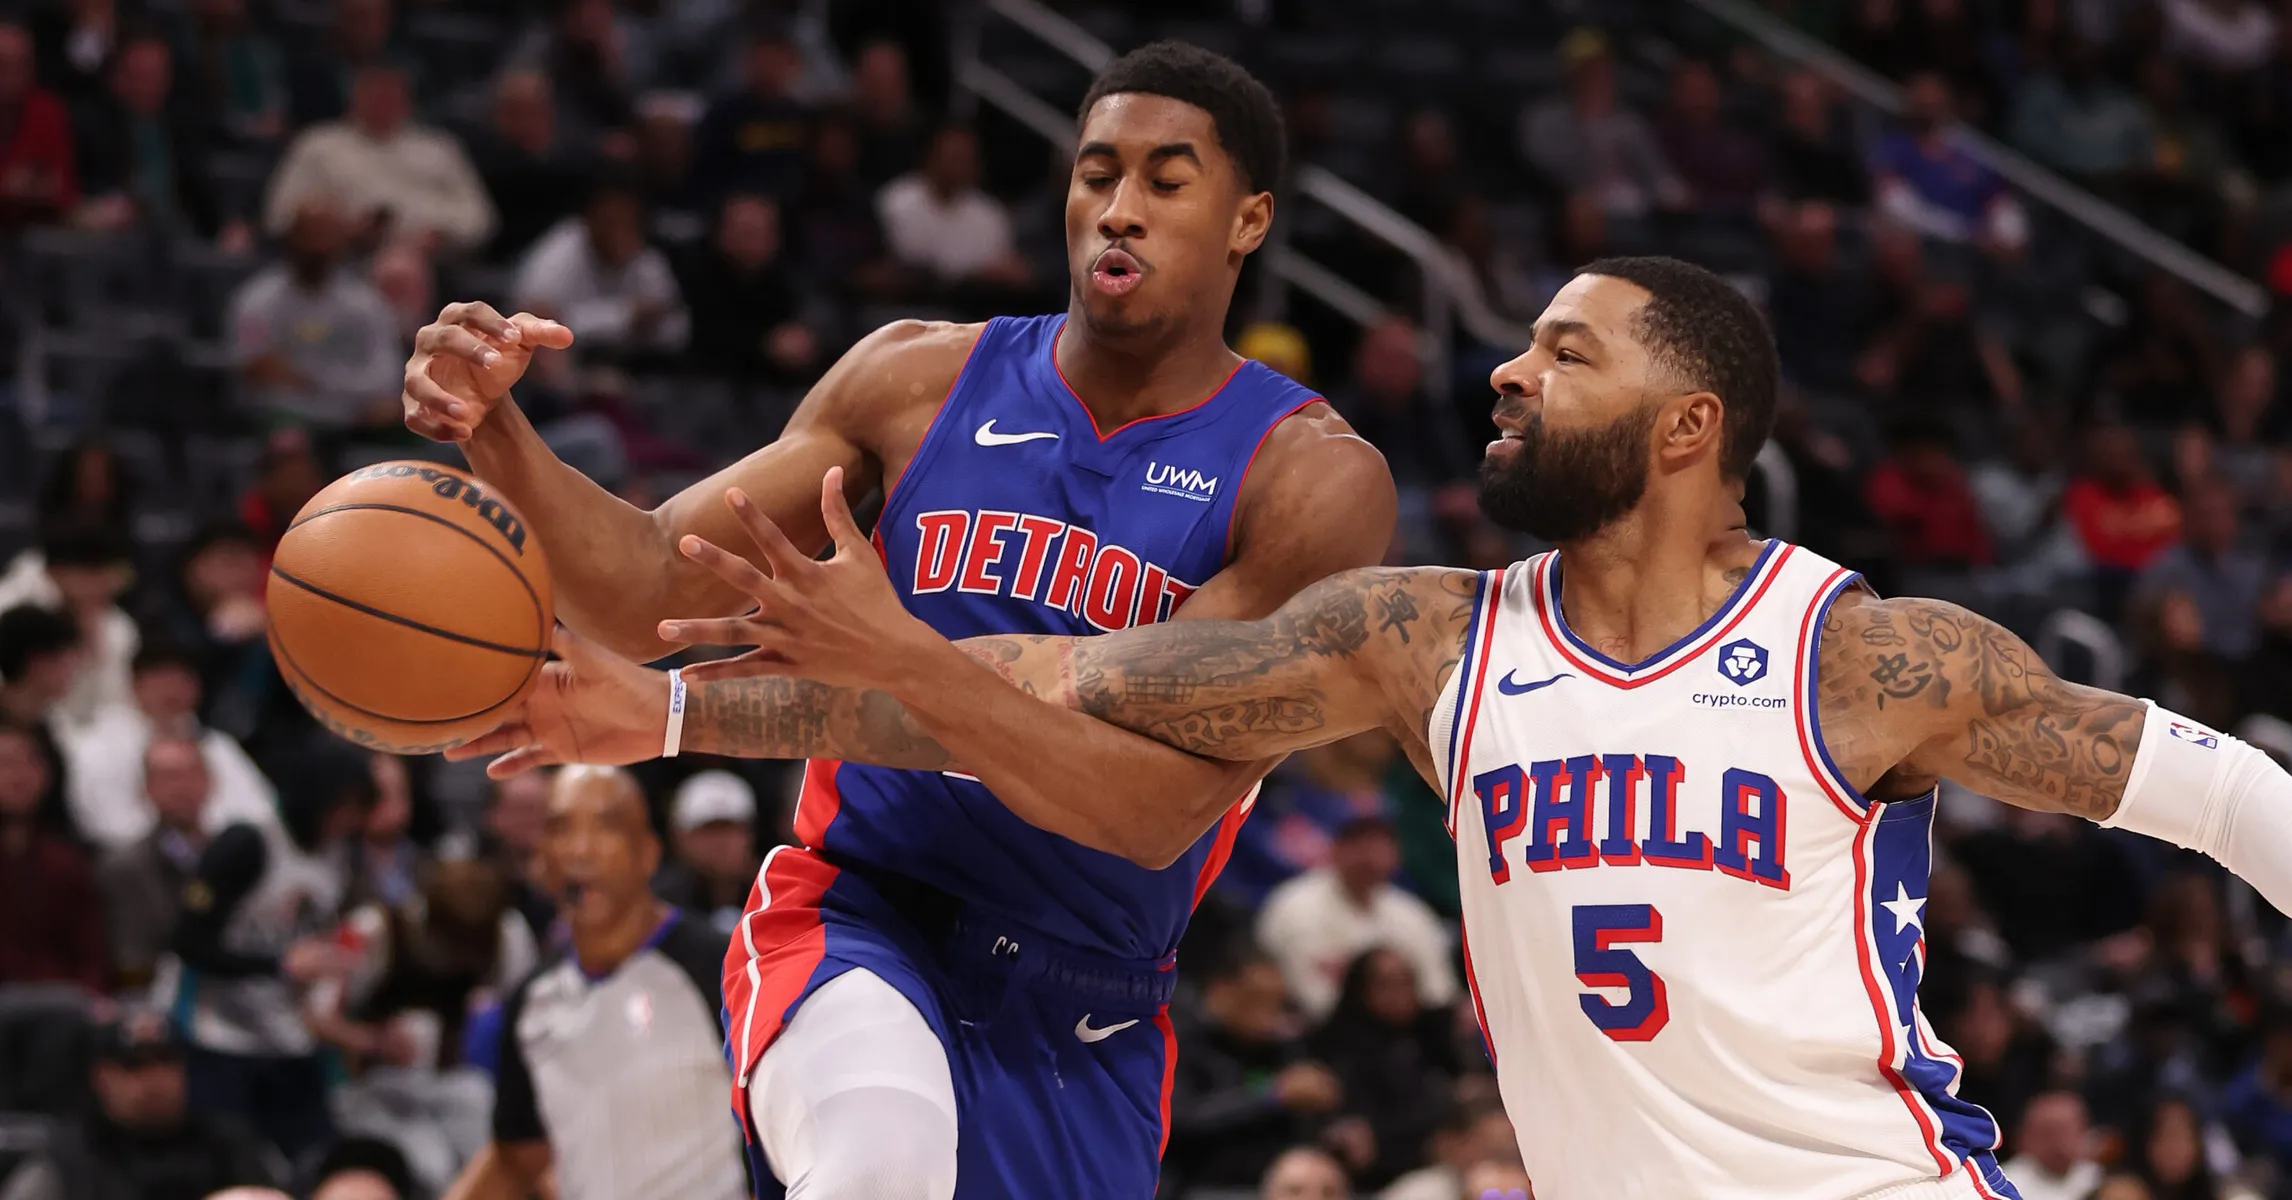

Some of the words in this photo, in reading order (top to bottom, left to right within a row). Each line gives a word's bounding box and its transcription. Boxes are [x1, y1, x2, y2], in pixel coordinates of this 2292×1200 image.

[1141, 485, 1158, 493] UNITED
[1158, 488, 1185, 498] WHOLESALE
[1184, 493, 1211, 502] MORTGAGE
[1146, 461, 1218, 495] UWM
[1692, 693, 1787, 709] crypto.com
[1473, 754, 1791, 891] PHILA
[1572, 904, 1669, 1041] 5
